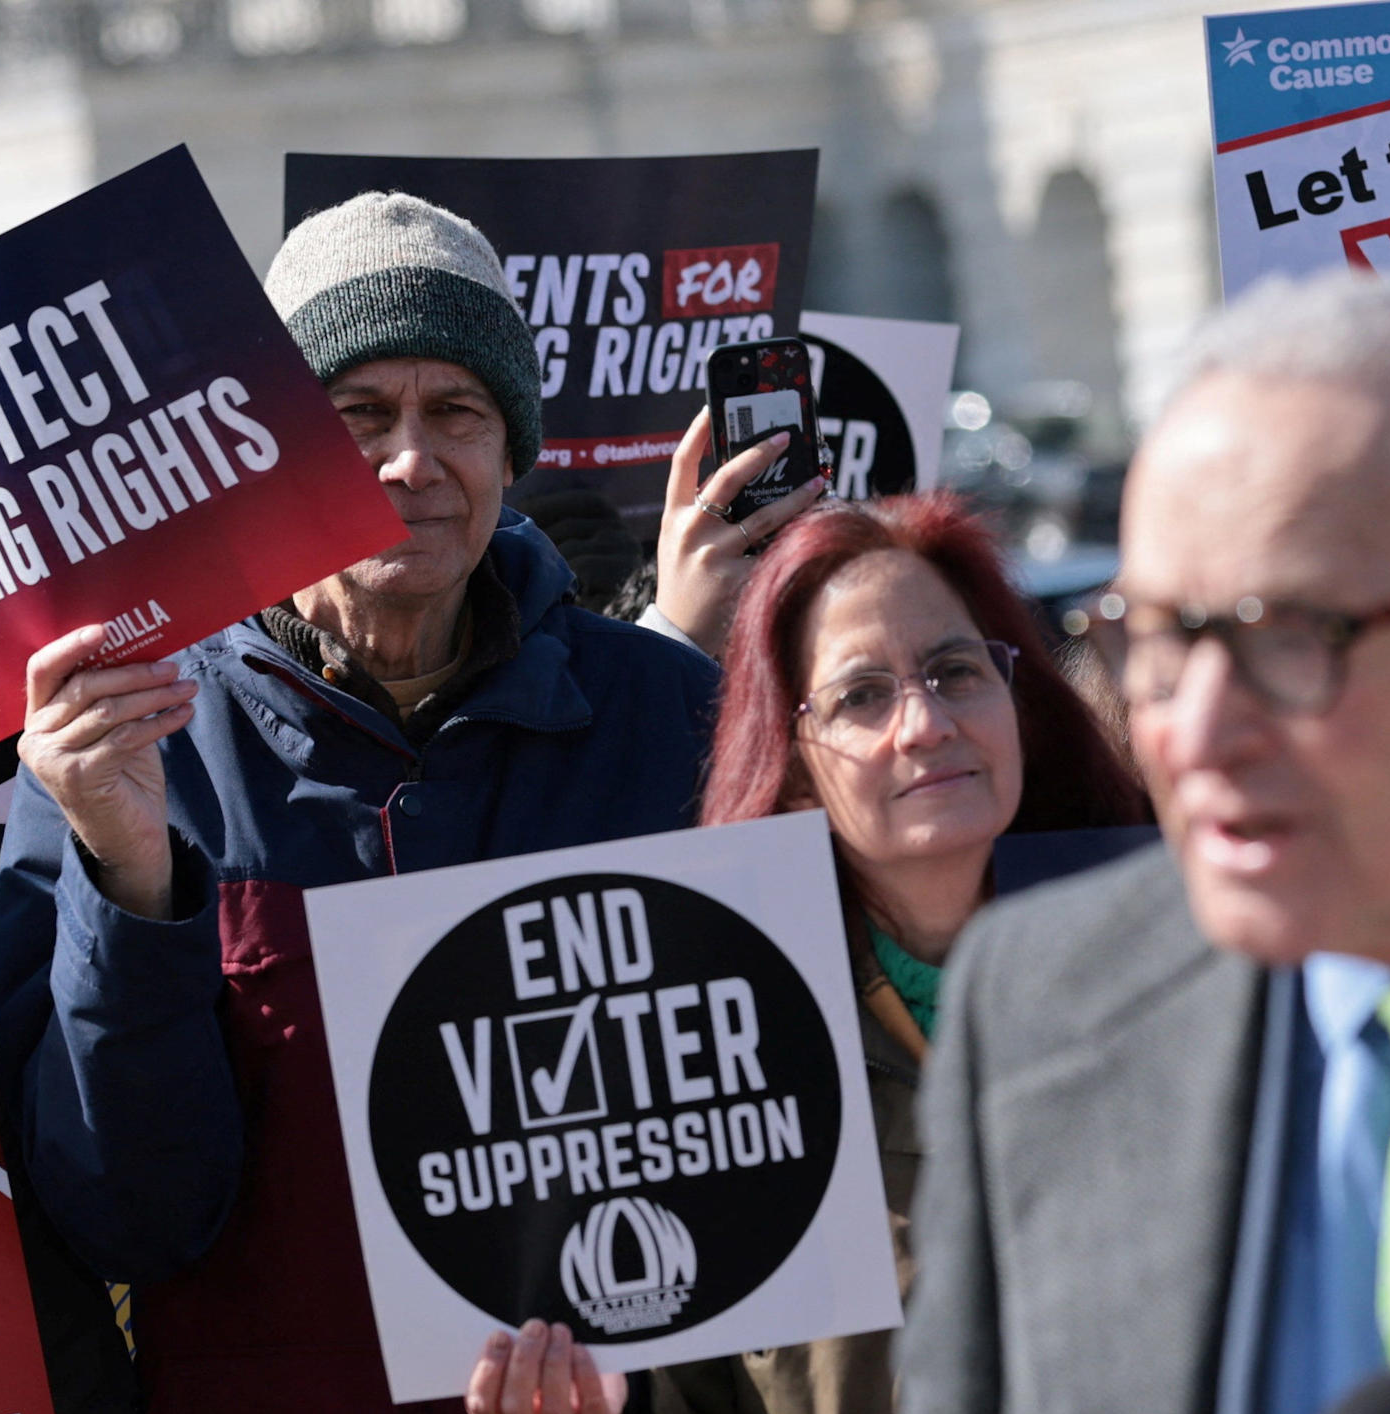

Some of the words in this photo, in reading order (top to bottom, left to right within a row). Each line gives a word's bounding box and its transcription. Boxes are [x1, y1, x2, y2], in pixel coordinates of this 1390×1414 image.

[1269, 63, 1374, 91] Cause
[1245, 147, 1376, 231] Let
[504, 252, 650, 326] ENTS
[676, 257, 762, 308] FOR
[28, 375, 280, 564] RIGHTS
[99, 598, 172, 655] DILLA
[503, 888, 654, 1000] END
[417, 1095, 805, 1218] SUPPRESSION
[560, 1196, 697, 1309] NOW
